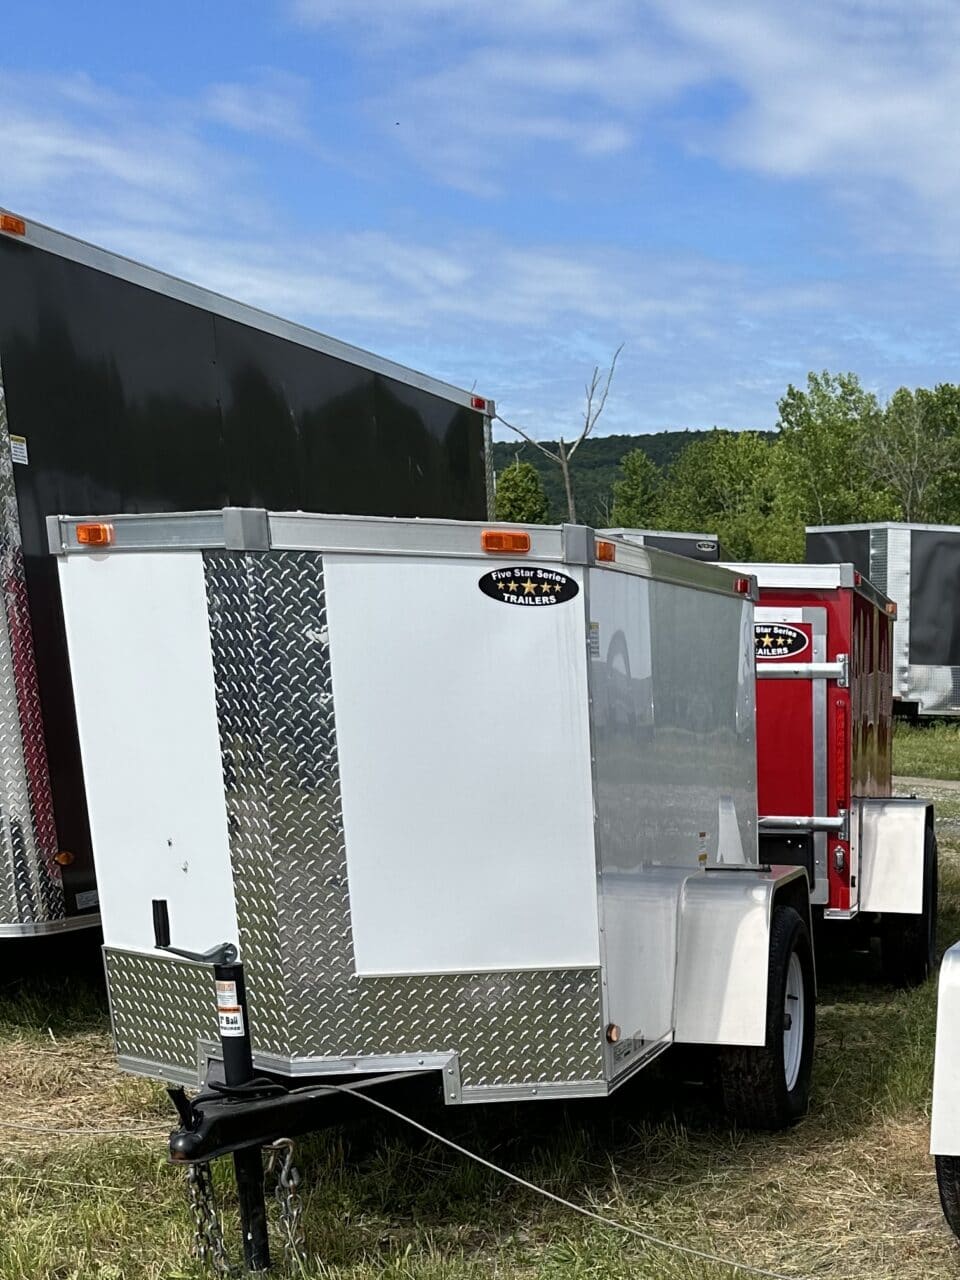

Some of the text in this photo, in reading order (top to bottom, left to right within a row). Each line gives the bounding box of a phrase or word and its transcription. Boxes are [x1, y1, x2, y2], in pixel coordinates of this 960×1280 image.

[491, 568, 567, 584] Five Star Series
[502, 592, 557, 605] TRAILERS
[755, 626, 797, 638] Star Series
[756, 646, 789, 656] AILERS
